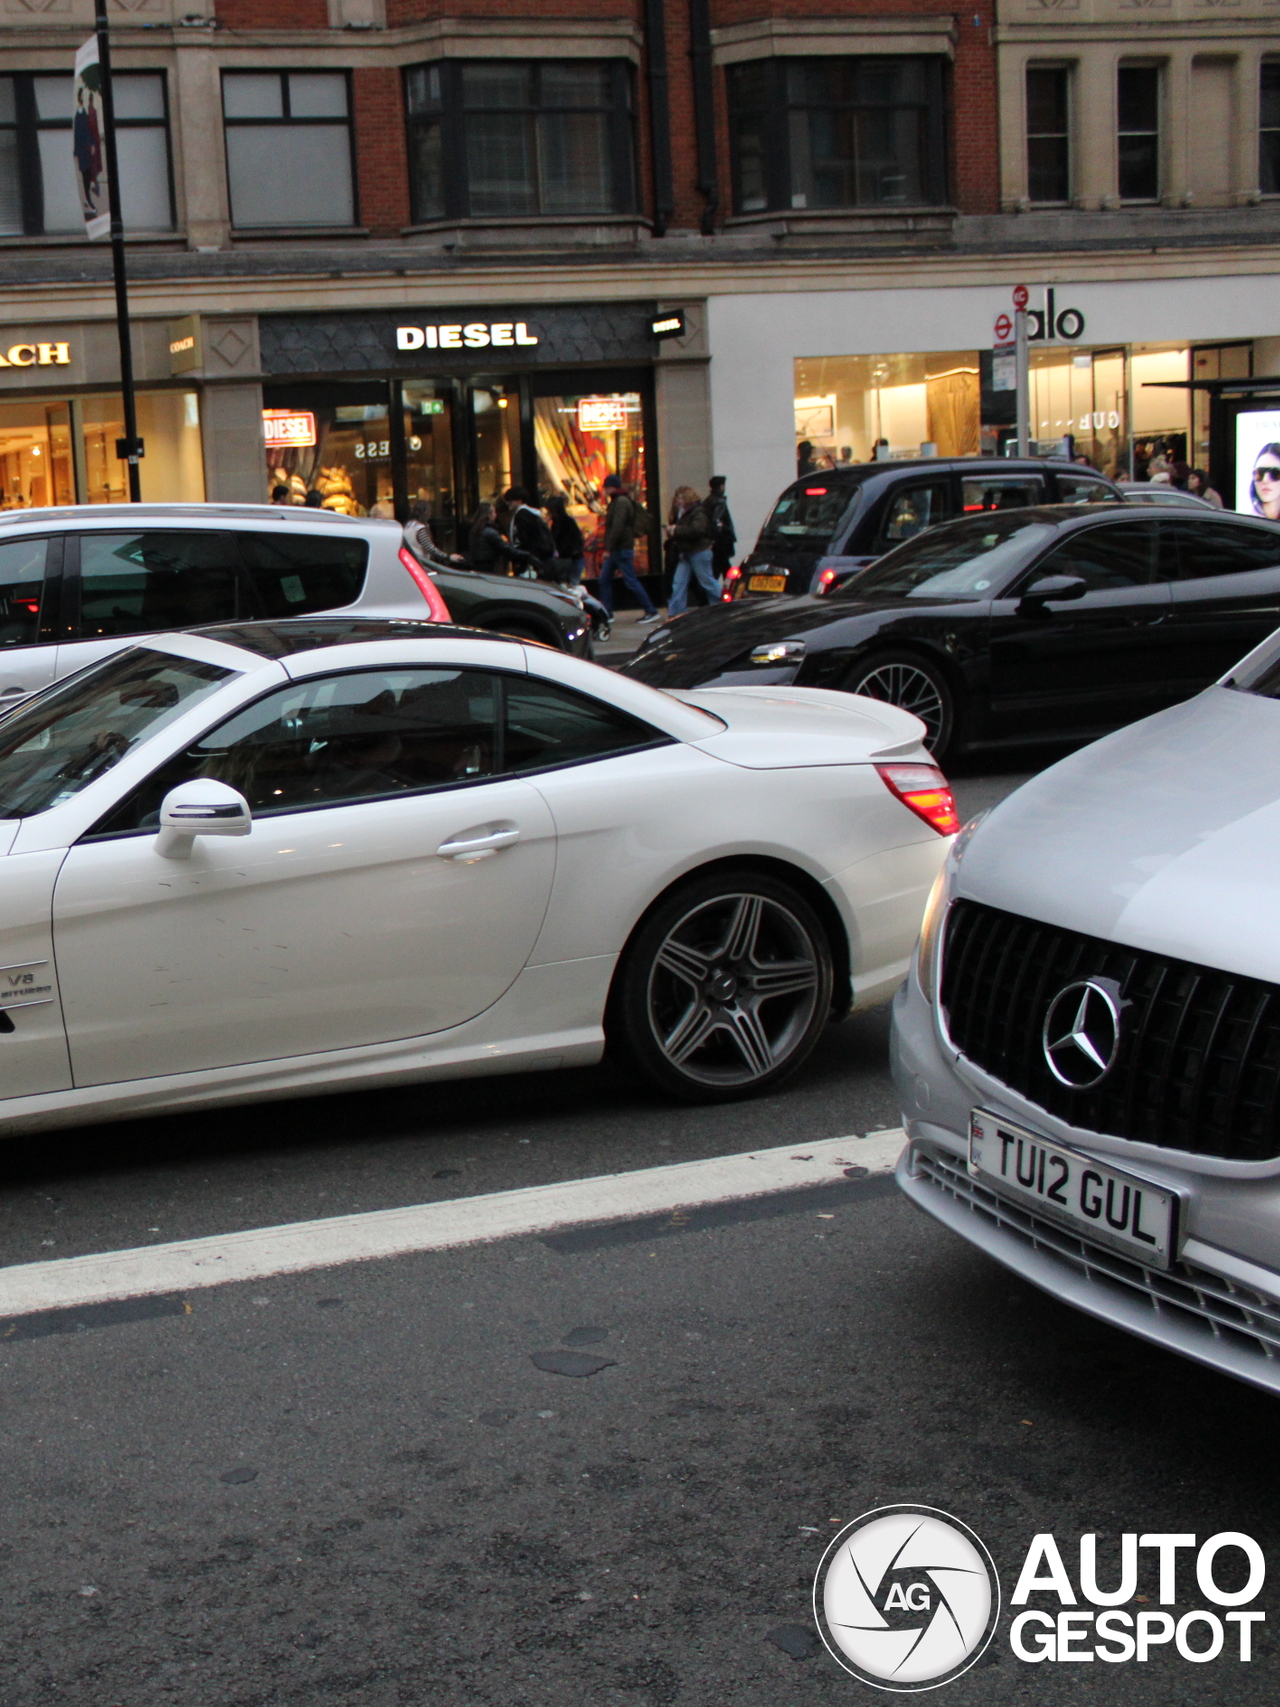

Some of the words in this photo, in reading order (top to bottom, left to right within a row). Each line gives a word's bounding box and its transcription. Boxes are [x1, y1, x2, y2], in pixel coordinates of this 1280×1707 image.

[1026, 287, 1085, 341] alo
[170, 336, 194, 354] COACH
[396, 322, 539, 351] DIESEL
[582, 402, 624, 423] DIESEL
[264, 417, 311, 439] DIESEL
[7, 973, 35, 986] V8
[1, 985, 52, 998] BITURBO
[996, 1129, 1069, 1206] TU12
[1080, 1169, 1156, 1246] GUL
